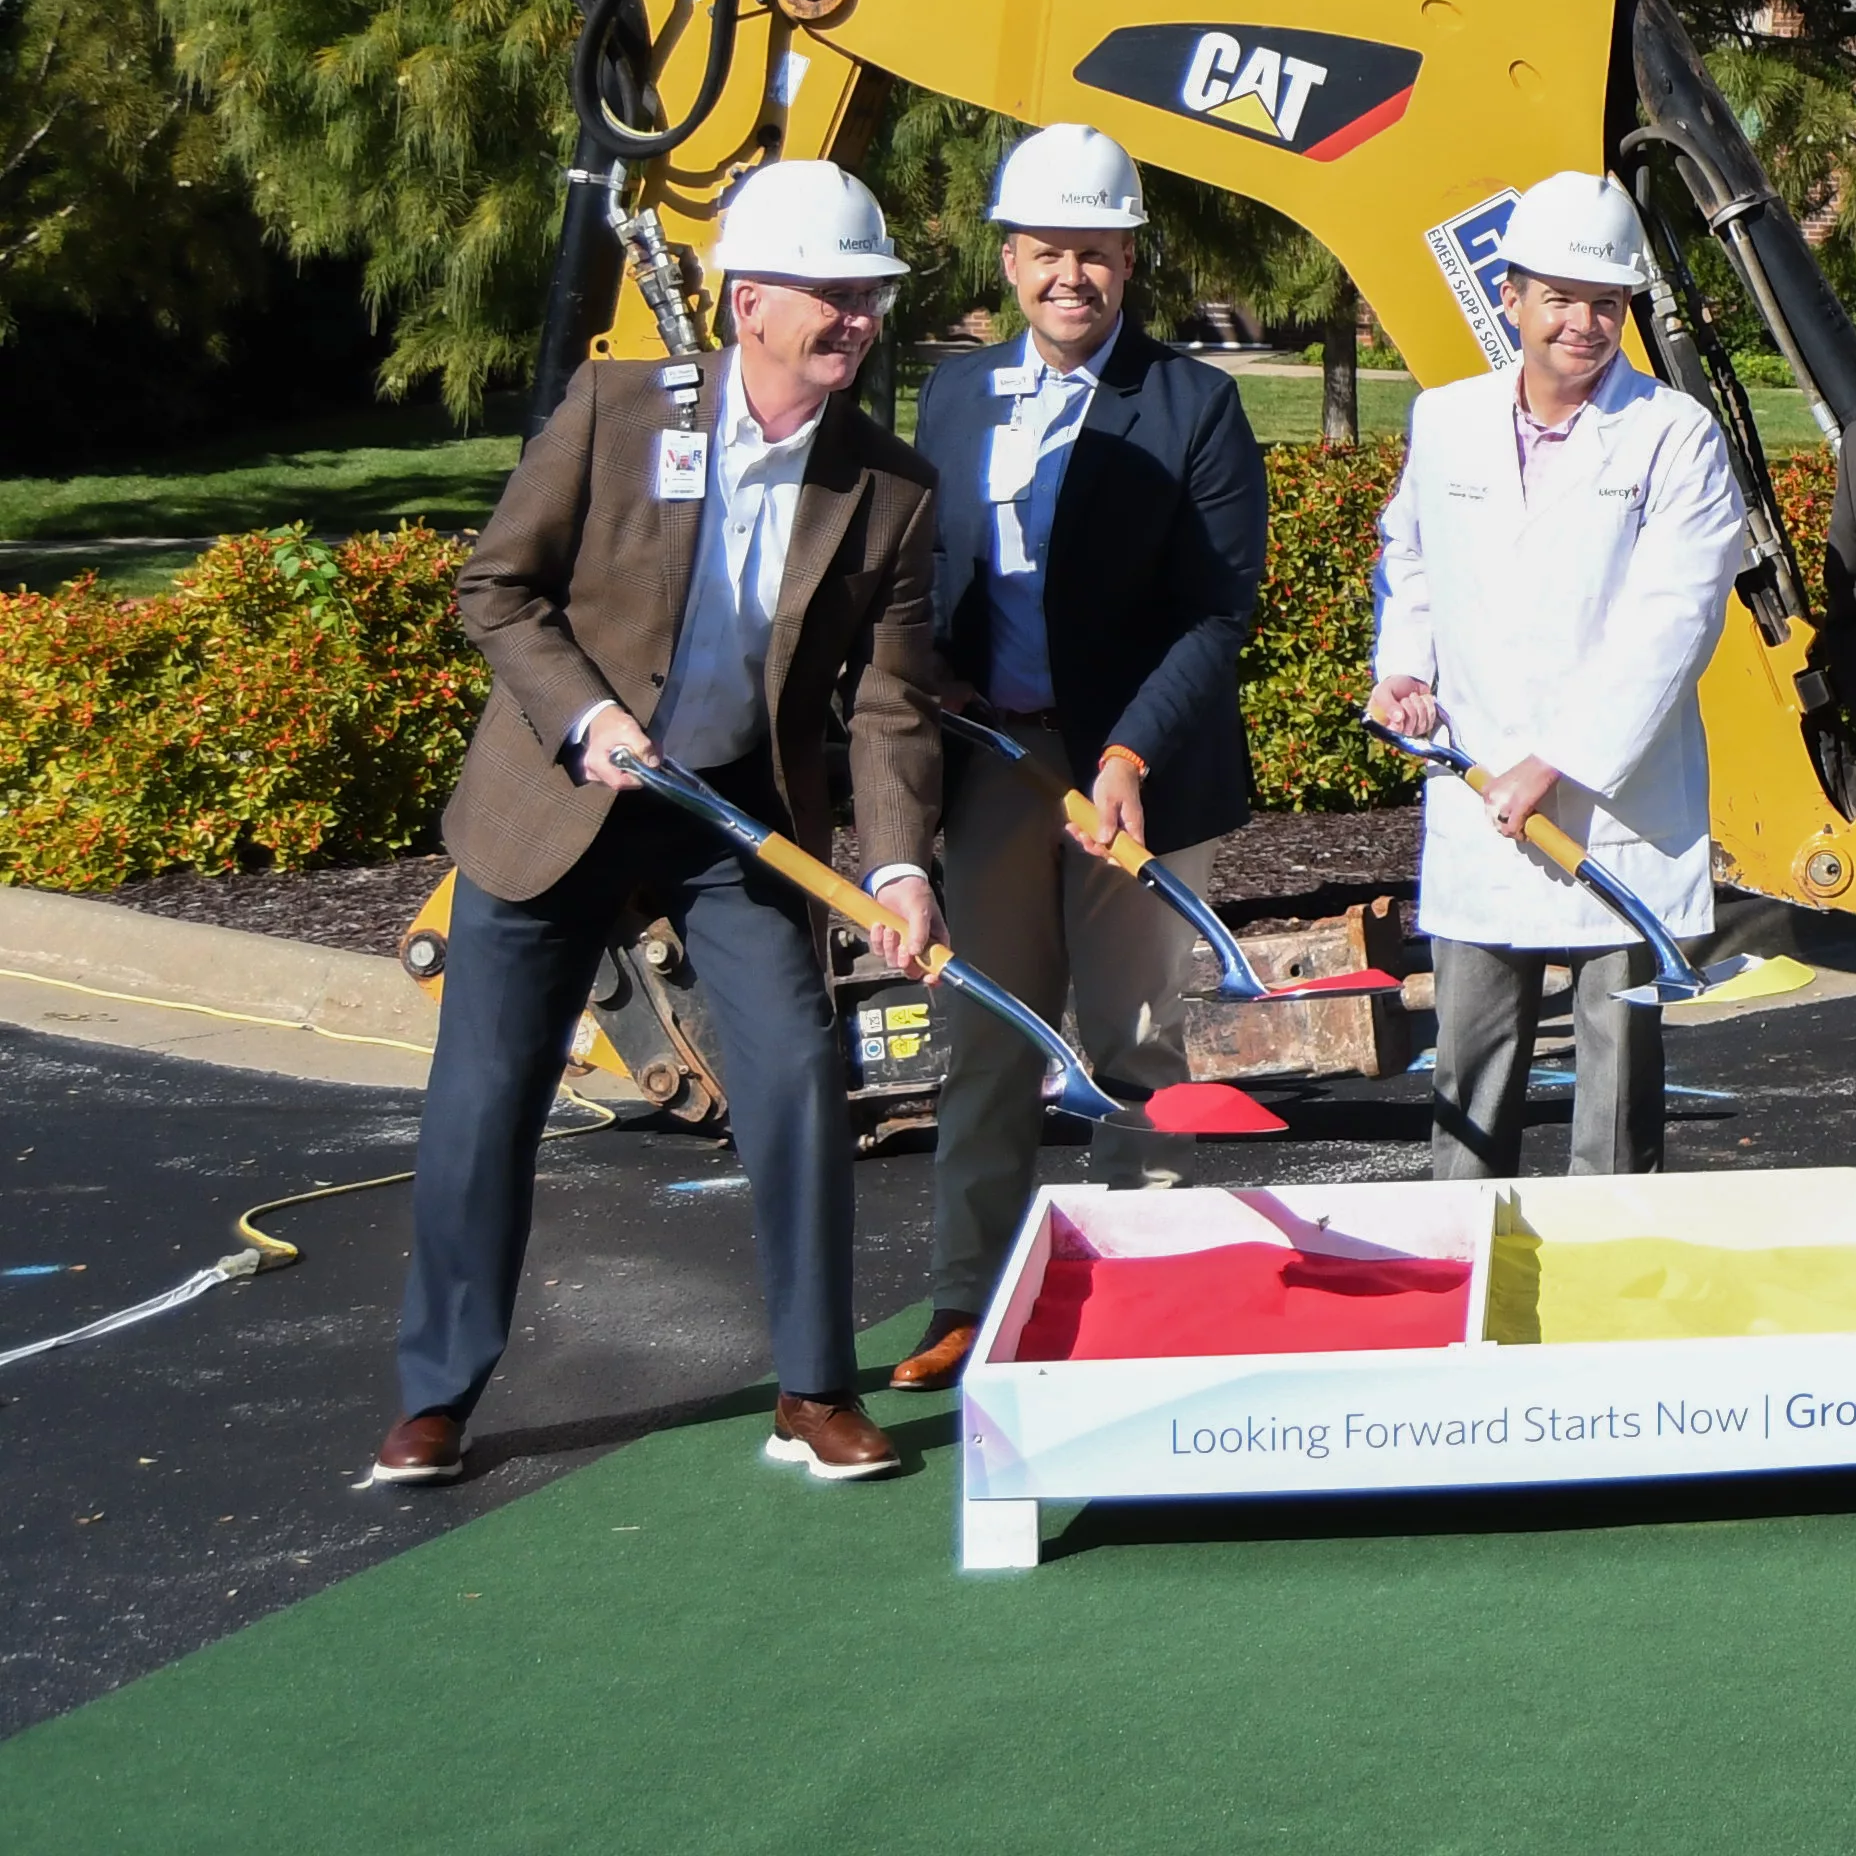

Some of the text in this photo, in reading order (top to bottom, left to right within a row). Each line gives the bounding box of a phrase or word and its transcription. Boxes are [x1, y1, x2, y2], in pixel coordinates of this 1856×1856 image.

[1183, 31, 1328, 142] CAT
[1061, 193, 1099, 206] Mercy
[838, 237, 874, 253] Mercy
[1569, 241, 1606, 258] Mercy
[1427, 228, 1461, 277] EMERY
[1453, 279, 1480, 315] SAPP
[1472, 317, 1486, 330] &
[1480, 330, 1507, 371] SONS
[1172, 1416, 1331, 1459] Looking
[1345, 1406, 1508, 1449] Forward
[1524, 1405, 1641, 1443] Starts
[1657, 1399, 1749, 1437] Now
